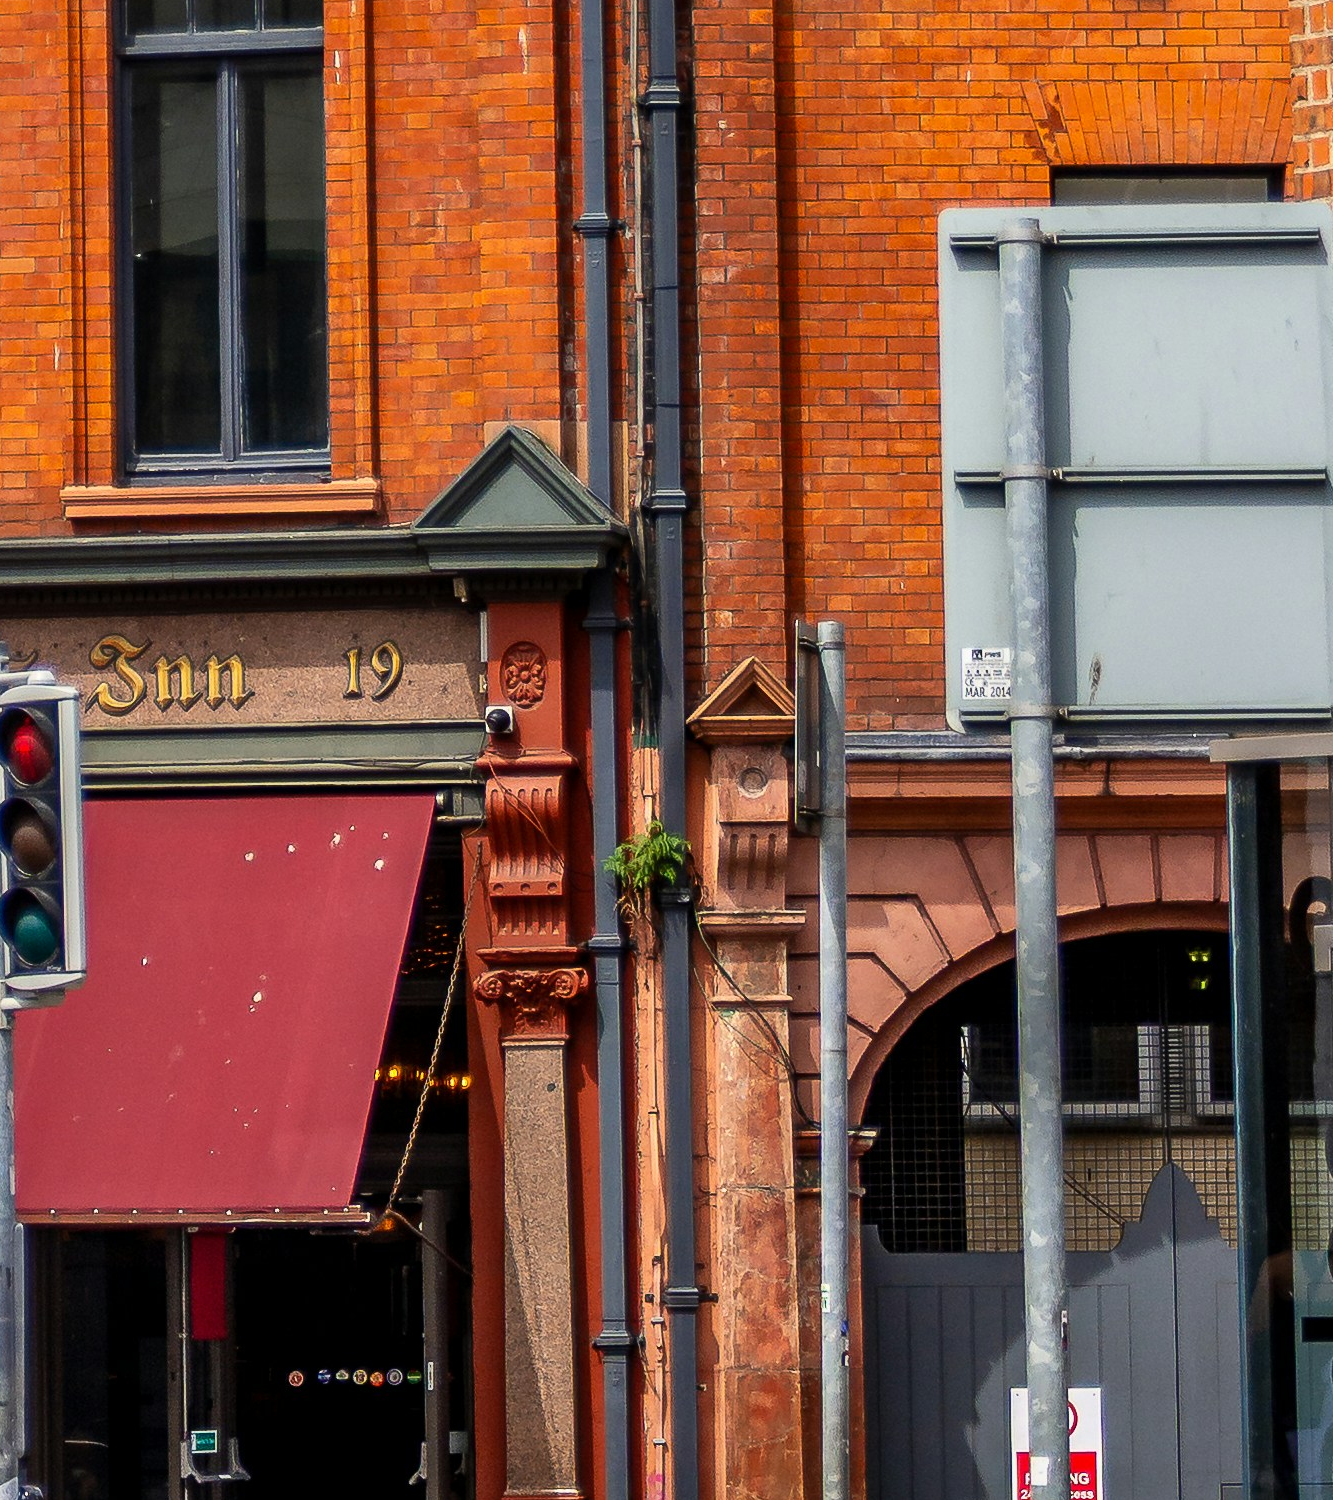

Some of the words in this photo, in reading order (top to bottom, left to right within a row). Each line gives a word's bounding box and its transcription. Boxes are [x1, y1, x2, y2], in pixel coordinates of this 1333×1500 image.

[85, 633, 254, 717] Inn
[343, 641, 404, 703] 19
[990, 686, 1012, 698] 2014
